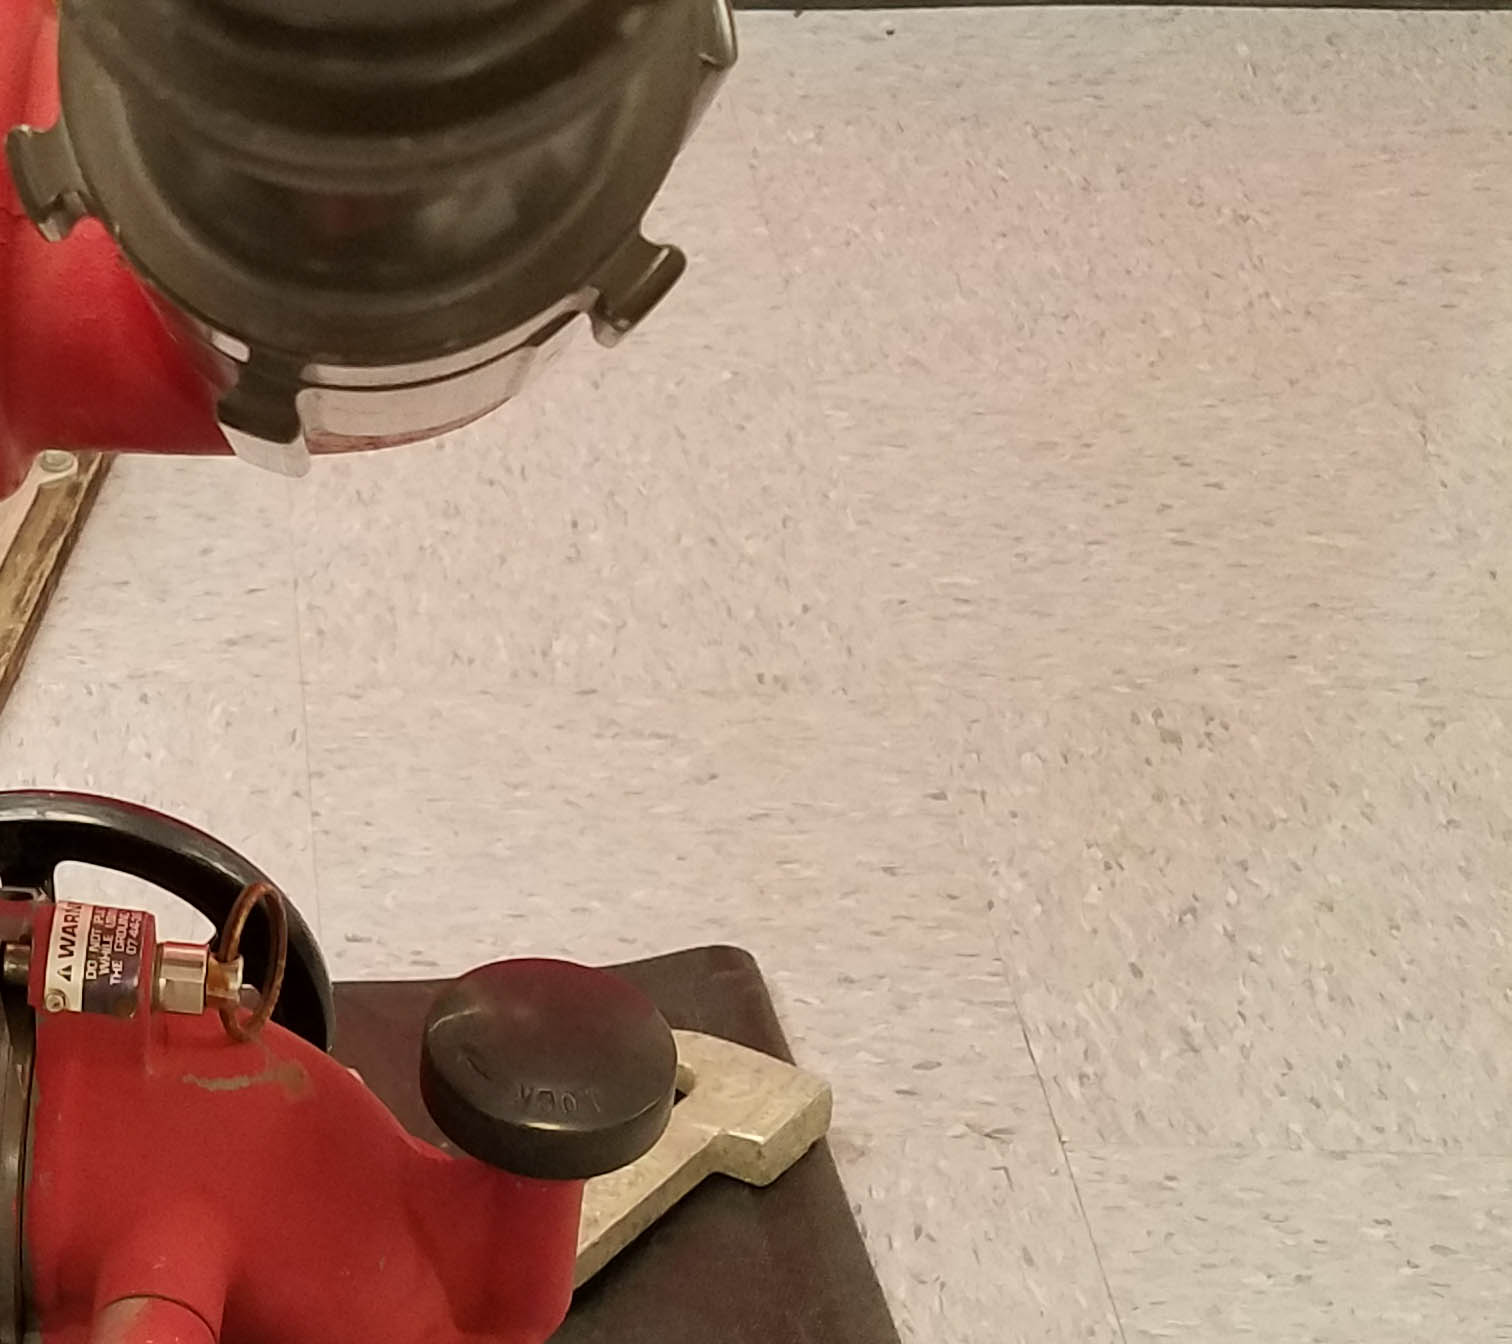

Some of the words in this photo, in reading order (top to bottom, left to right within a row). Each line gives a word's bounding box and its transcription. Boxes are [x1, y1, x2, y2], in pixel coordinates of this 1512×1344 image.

[57, 903, 82, 959] WARN
[89, 927, 102, 952] NOT
[98, 934, 113, 975] WHILE
[85, 959, 98, 980] DO
[109, 959, 123, 985] THE
